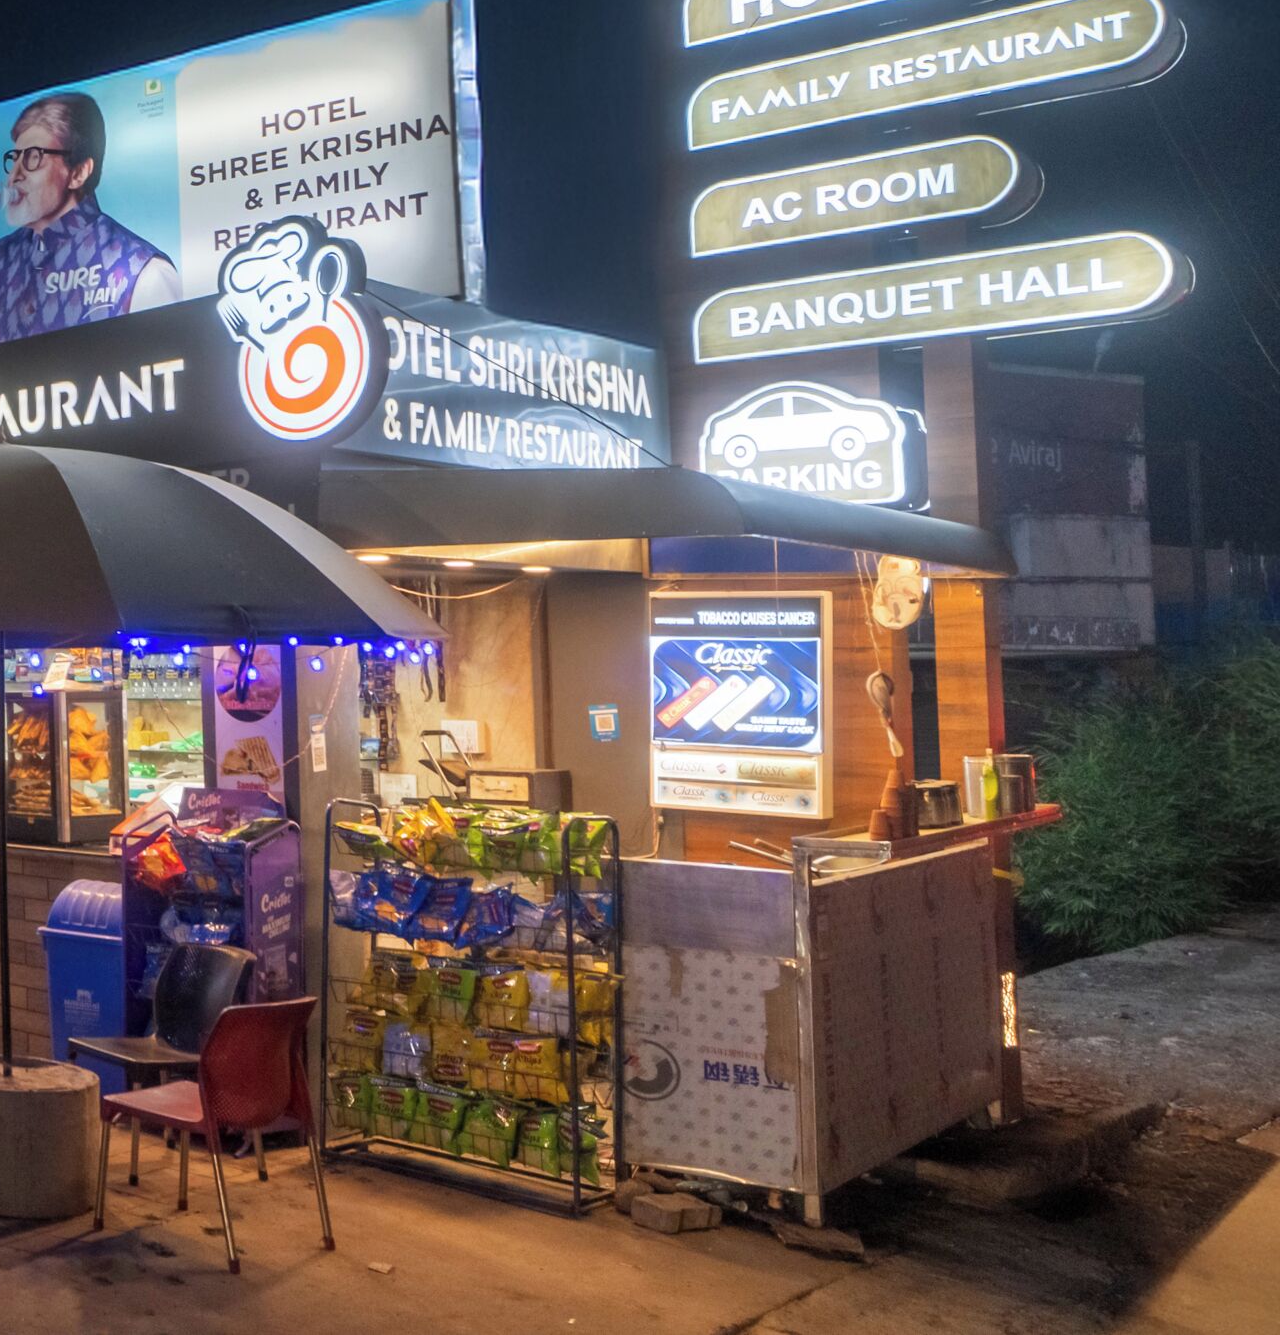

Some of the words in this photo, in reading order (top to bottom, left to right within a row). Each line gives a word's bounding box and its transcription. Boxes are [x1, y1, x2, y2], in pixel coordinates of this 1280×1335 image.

[711, 71, 850, 124] FAMILY
[869, 10, 1131, 90] RESTAURANT
[261, 96, 367, 138] HOTEL
[189, 147, 289, 187] SHREE
[299, 114, 451, 166] KRISHNA
[244, 188, 264, 211] &
[274, 162, 390, 205] FAMILY
[742, 191, 802, 228] AC
[816, 163, 955, 216] ROOM
[214, 192, 428, 250] REURANT
[45, 264, 102, 293] SURE
[729, 277, 963, 338] BANQUET
[978, 257, 1124, 306] HALL
[383, 316, 461, 383] OTEL
[468, 334, 534, 395] SHRI
[541, 349, 652, 419] KRISHNA
[383, 398, 402, 440] &
[410, 402, 500, 453] FAMILY
[505, 416, 643, 470] RESTAURANT
[717, 459, 883, 493] RKING
[696, 611, 740, 626] TOBACCO
[741, 611, 776, 626] CAUSES
[777, 611, 816, 626] CANCER
[695, 642, 774, 666] Classic
